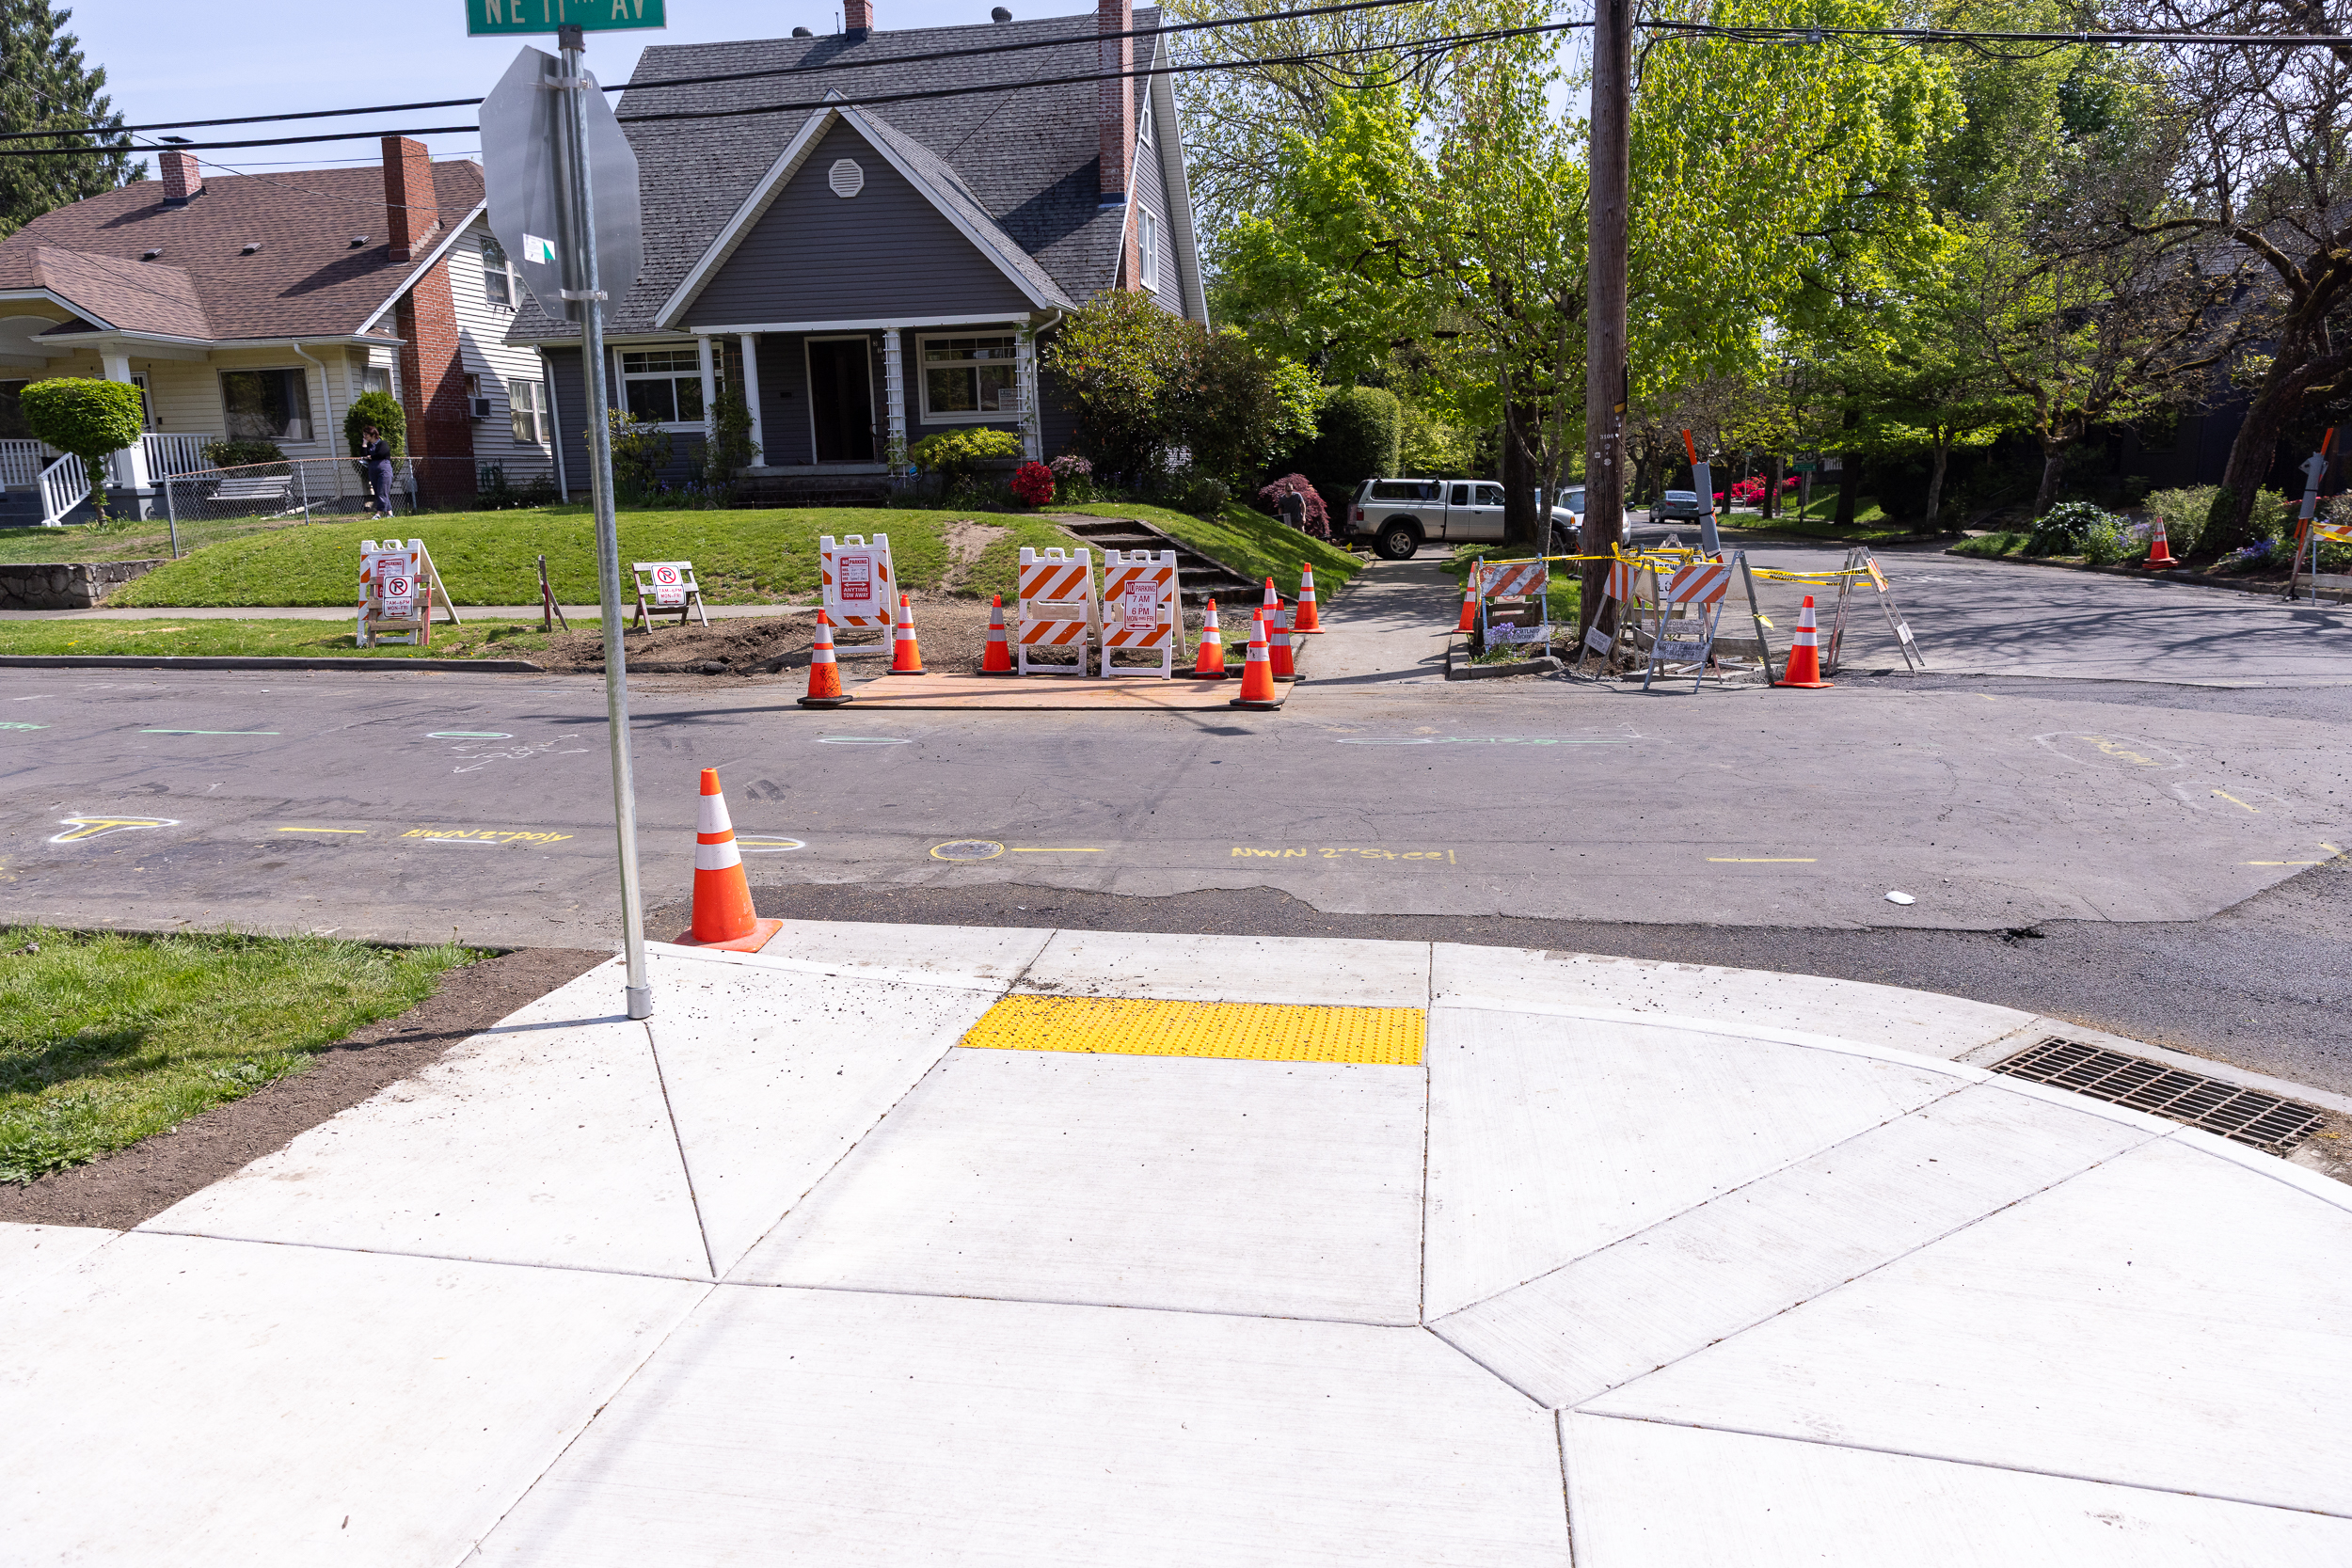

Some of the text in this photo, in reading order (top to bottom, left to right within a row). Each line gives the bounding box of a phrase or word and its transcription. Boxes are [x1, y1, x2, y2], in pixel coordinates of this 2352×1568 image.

[1796, 451, 1814, 461] 20
[1126, 583, 1135, 594] NO
[1232, 847, 1308, 858] NWN
